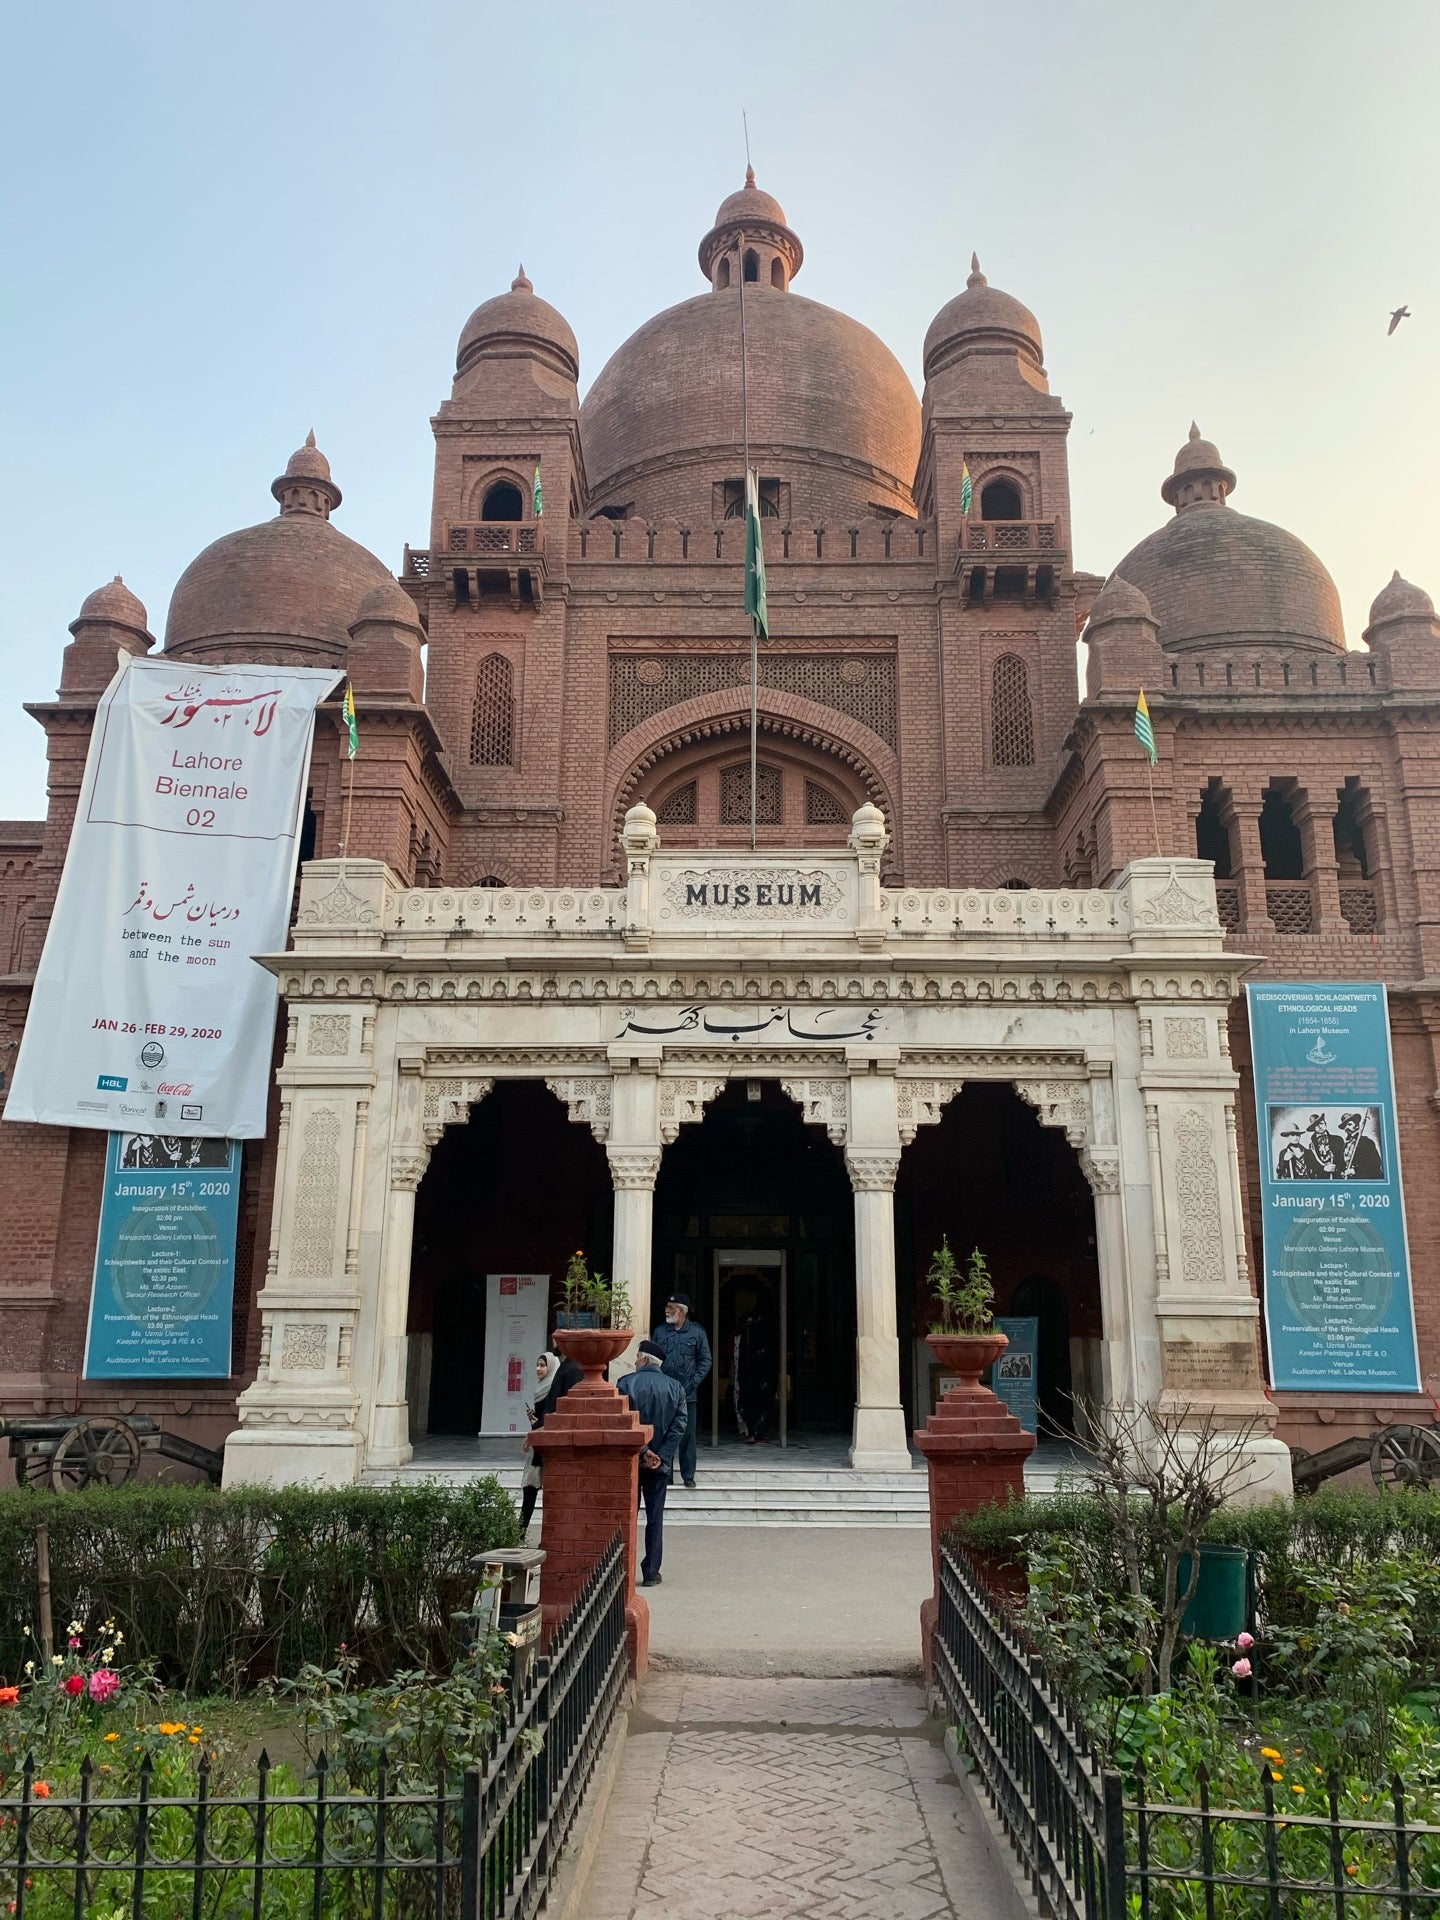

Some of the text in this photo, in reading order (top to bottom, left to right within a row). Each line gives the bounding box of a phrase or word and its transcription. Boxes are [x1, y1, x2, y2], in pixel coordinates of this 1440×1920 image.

[172, 750, 243, 771] Lahore
[155, 776, 248, 800] Biennale
[186, 808, 216, 828] 02
[121, 882, 149, 916] قمر
[153, 883, 195, 921] شمس
[686, 884, 822, 909] MUSEUM
[187, 902, 240, 927] درمیان
[121, 929, 231, 949] between the sun
[129, 948, 217, 966] and the moon
[1257, 993, 1314, 1001] REDISCOVERING
[91, 1018, 118, 1031] JAN
[121, 1022, 137, 1034] 26
[145, 1023, 166, 1035] FEB
[169, 1026, 188, 1039] 29,
[191, 1028, 222, 1040] 2020
[614, 1005, 884, 1042] عجائب گھر
[102, 1079, 123, 1088] HBL
[114, 1183, 166, 1199] January
[199, 1182, 230, 1196] 2020
[1272, 1194, 1325, 1210] January
[1359, 1194, 1390, 1208] 2020
[132, 1205, 169, 1213] Inauguration
[1293, 1216, 1330, 1224] Inauguration
[119, 1234, 152, 1242] Manuscripts
[1284, 1245, 1317, 1253] Manuscripts
[142, 1266, 153, 1274] the
[162, 1313, 199, 1321] Ethnological
[1281, 1325, 1320, 1333] Preservation
[1341, 1325, 1379, 1334] Ethnological
[115, 1338, 140, 1346] Keeper
[141, 1338, 170, 1346] Paintings
[178, 1337, 190, 1345] RE
[105, 1356, 140, 1364] Auditorium
[157, 1356, 181, 1364] Lahore
[1298, 1350, 1323, 1358] Keeper
[1323, 1350, 1354, 1358] Paintings
[1291, 1368, 1327, 1376] Auditorium
